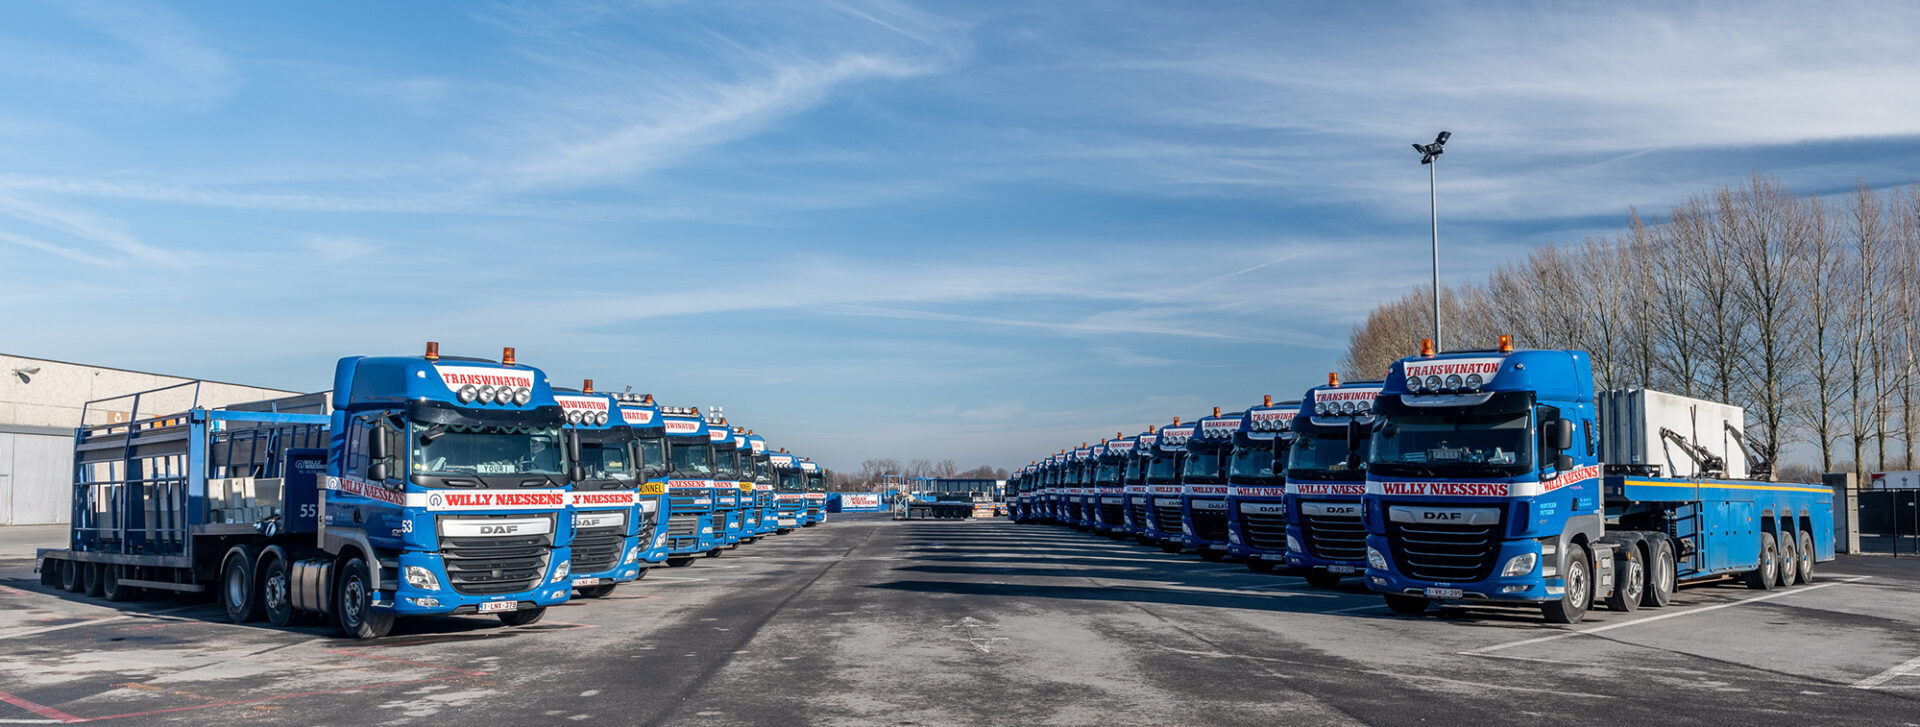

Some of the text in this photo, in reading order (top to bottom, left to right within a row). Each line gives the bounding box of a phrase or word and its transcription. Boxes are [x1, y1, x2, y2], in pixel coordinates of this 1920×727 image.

[1406, 363, 1500, 376] TRANSWINATON
[443, 373, 531, 387] TRANSWINATON
[1316, 391, 1378, 401] TRANSWINATO
[559, 400, 607, 410] NSWINATON
[1252, 412, 1297, 421] TRANSWINAT
[665, 422, 696, 430] SWINATON
[1543, 476, 1563, 492] WILLY
[1563, 466, 1598, 486] NAESSENS
[339, 478, 405, 506] WILLY NAESSENS
[1237, 487, 1286, 496] WILLY NAES
[1297, 485, 1366, 495] WILLY NAESS
[1383, 483, 1508, 496] WILLY NAESSENS
[444, 494, 563, 506] WILLY NAESSENS
[583, 494, 633, 504] NAESSENS
[299, 504, 319, 518] 55
[1423, 512, 1461, 520] DAF
[402, 520, 413, 533] 53
[480, 525, 518, 534] DAF
